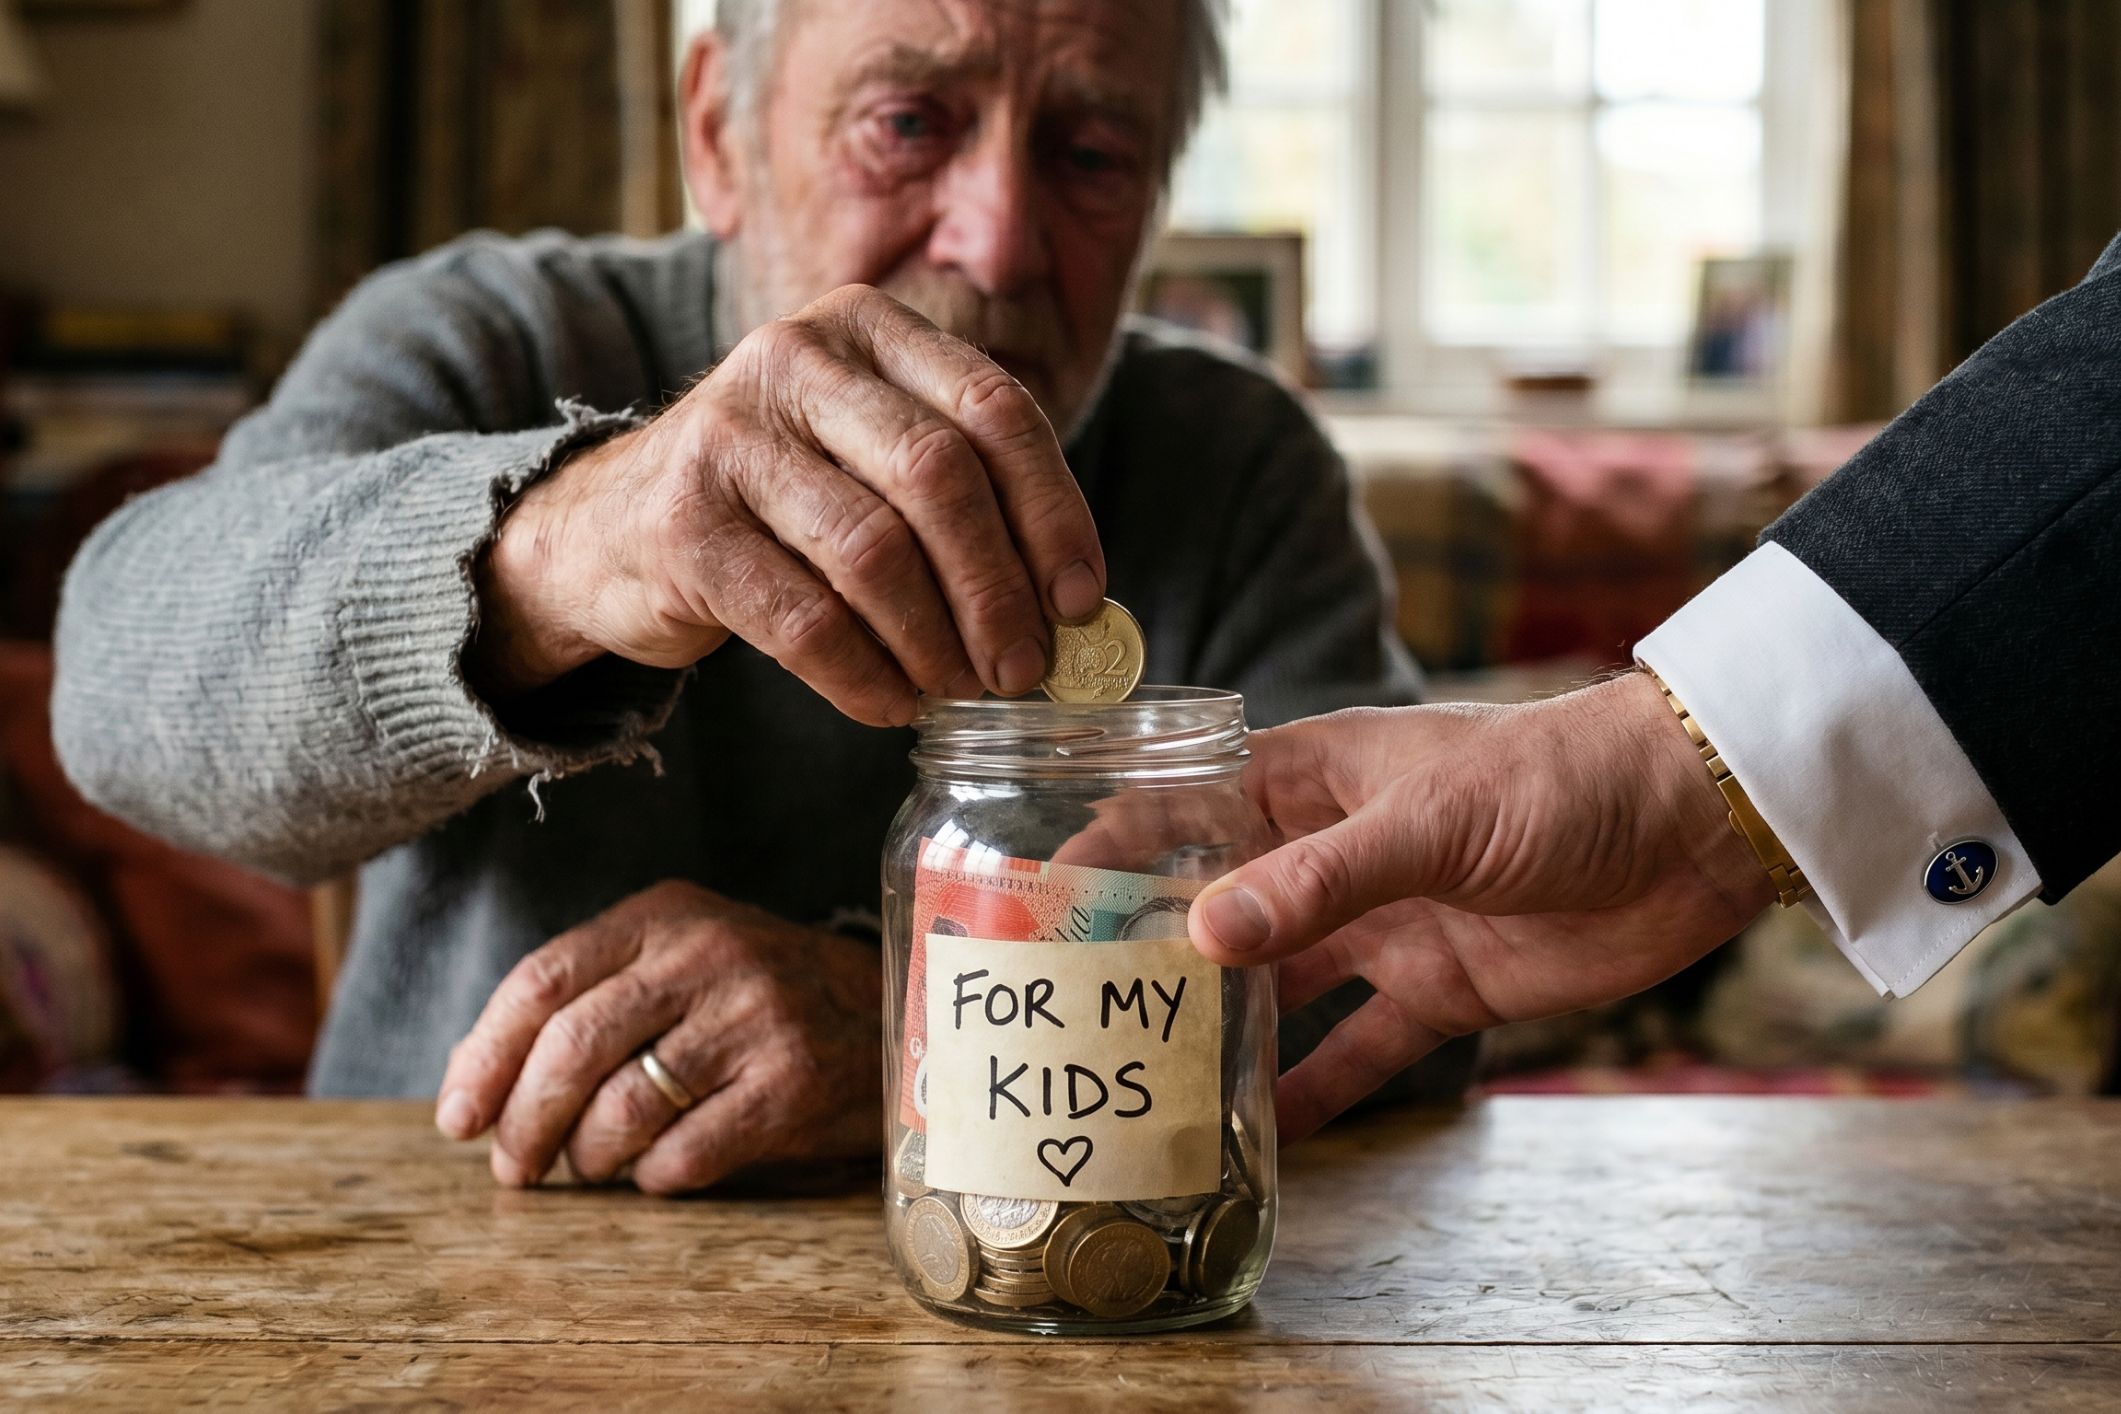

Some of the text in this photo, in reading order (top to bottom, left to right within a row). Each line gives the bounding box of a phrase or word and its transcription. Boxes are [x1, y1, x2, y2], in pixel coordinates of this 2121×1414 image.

[1104, 639, 1129, 676] 2
[953, 969, 1187, 1043] FOR MY
[989, 1055, 1153, 1120] KIDS
